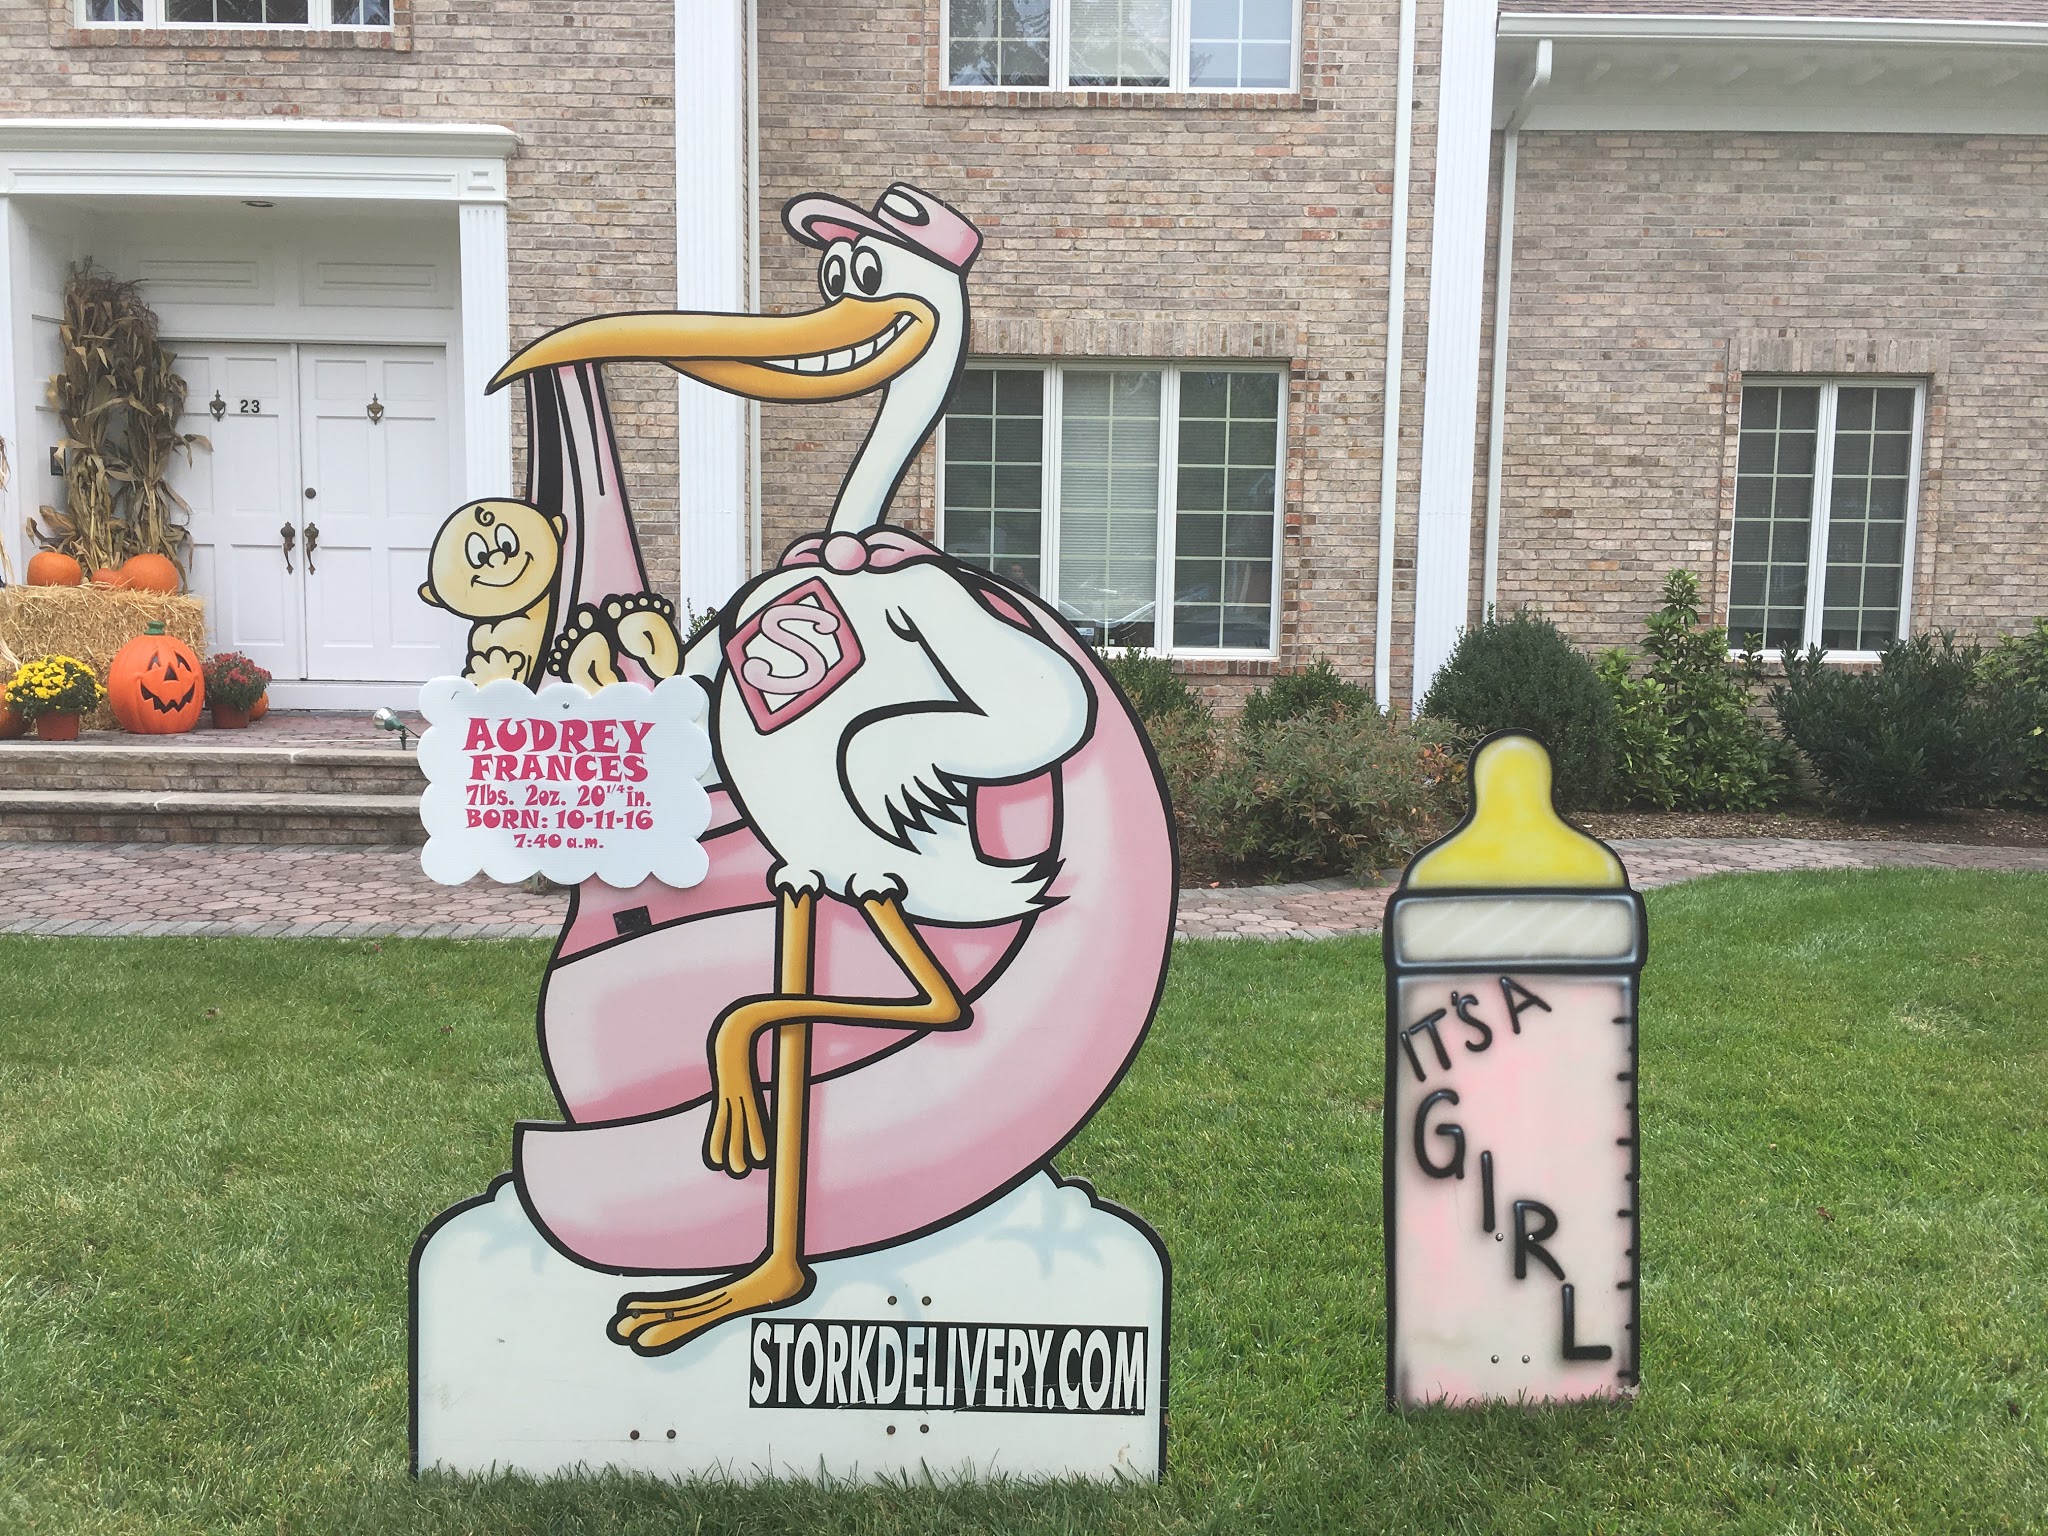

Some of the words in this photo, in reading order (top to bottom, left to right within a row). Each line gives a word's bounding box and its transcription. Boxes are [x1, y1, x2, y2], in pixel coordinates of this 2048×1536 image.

[240, 400, 260, 414] 23
[463, 717, 656, 755] AUDREY
[470, 753, 649, 783] FRANCES
[466, 784, 515, 806] 7lbs.
[525, 784, 567, 807] 2oz.
[465, 808, 548, 830] BORN:
[555, 809, 654, 830] 10-11-16
[514, 833, 562, 849] 7:40
[566, 837, 604, 849] a.m.
[1400, 990, 1494, 1083] IT'S
[1499, 976, 1553, 1035] A
[1413, 1088, 1613, 1361] GIRL
[750, 1321, 1147, 1411] STORKDELIVERY.COM
